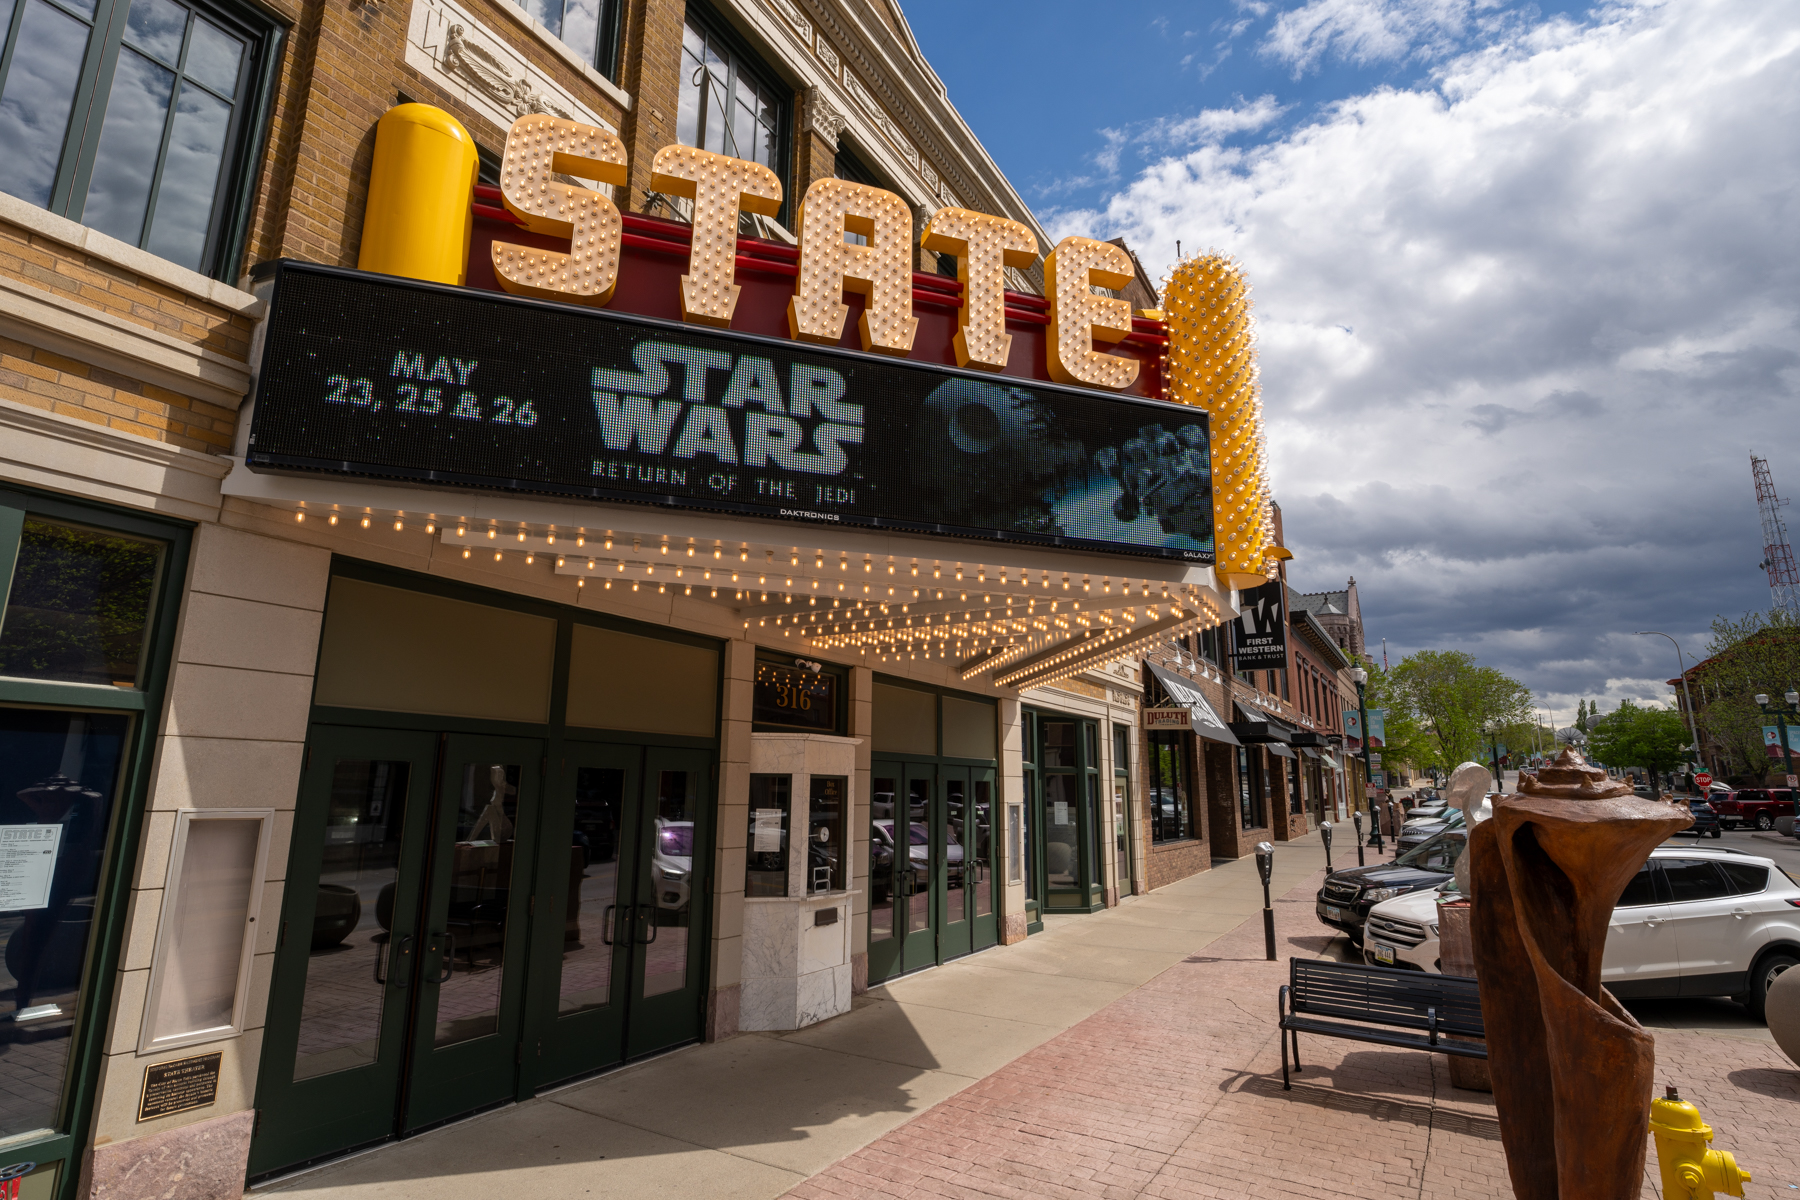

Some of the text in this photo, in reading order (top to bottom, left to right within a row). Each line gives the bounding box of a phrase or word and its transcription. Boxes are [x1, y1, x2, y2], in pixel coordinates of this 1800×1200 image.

[491, 113, 1140, 391] STATE
[390, 350, 479, 386] MAY
[591, 340, 865, 425] STAR
[325, 373, 538, 427] 23, 25 & 26
[592, 390, 865, 475] WARS
[592, 459, 856, 504] RETURN OF THE JEDI
[779, 508, 840, 521] DAKTRONICS
[1238, 645, 1284, 654] WESTERN
[1246, 637, 1273, 646] FIRST
[776, 685, 811, 711] 316
[1147, 711, 1188, 725] DULUTH
[825, 788, 837, 796] Office
[4, 829, 42, 840] STATE
